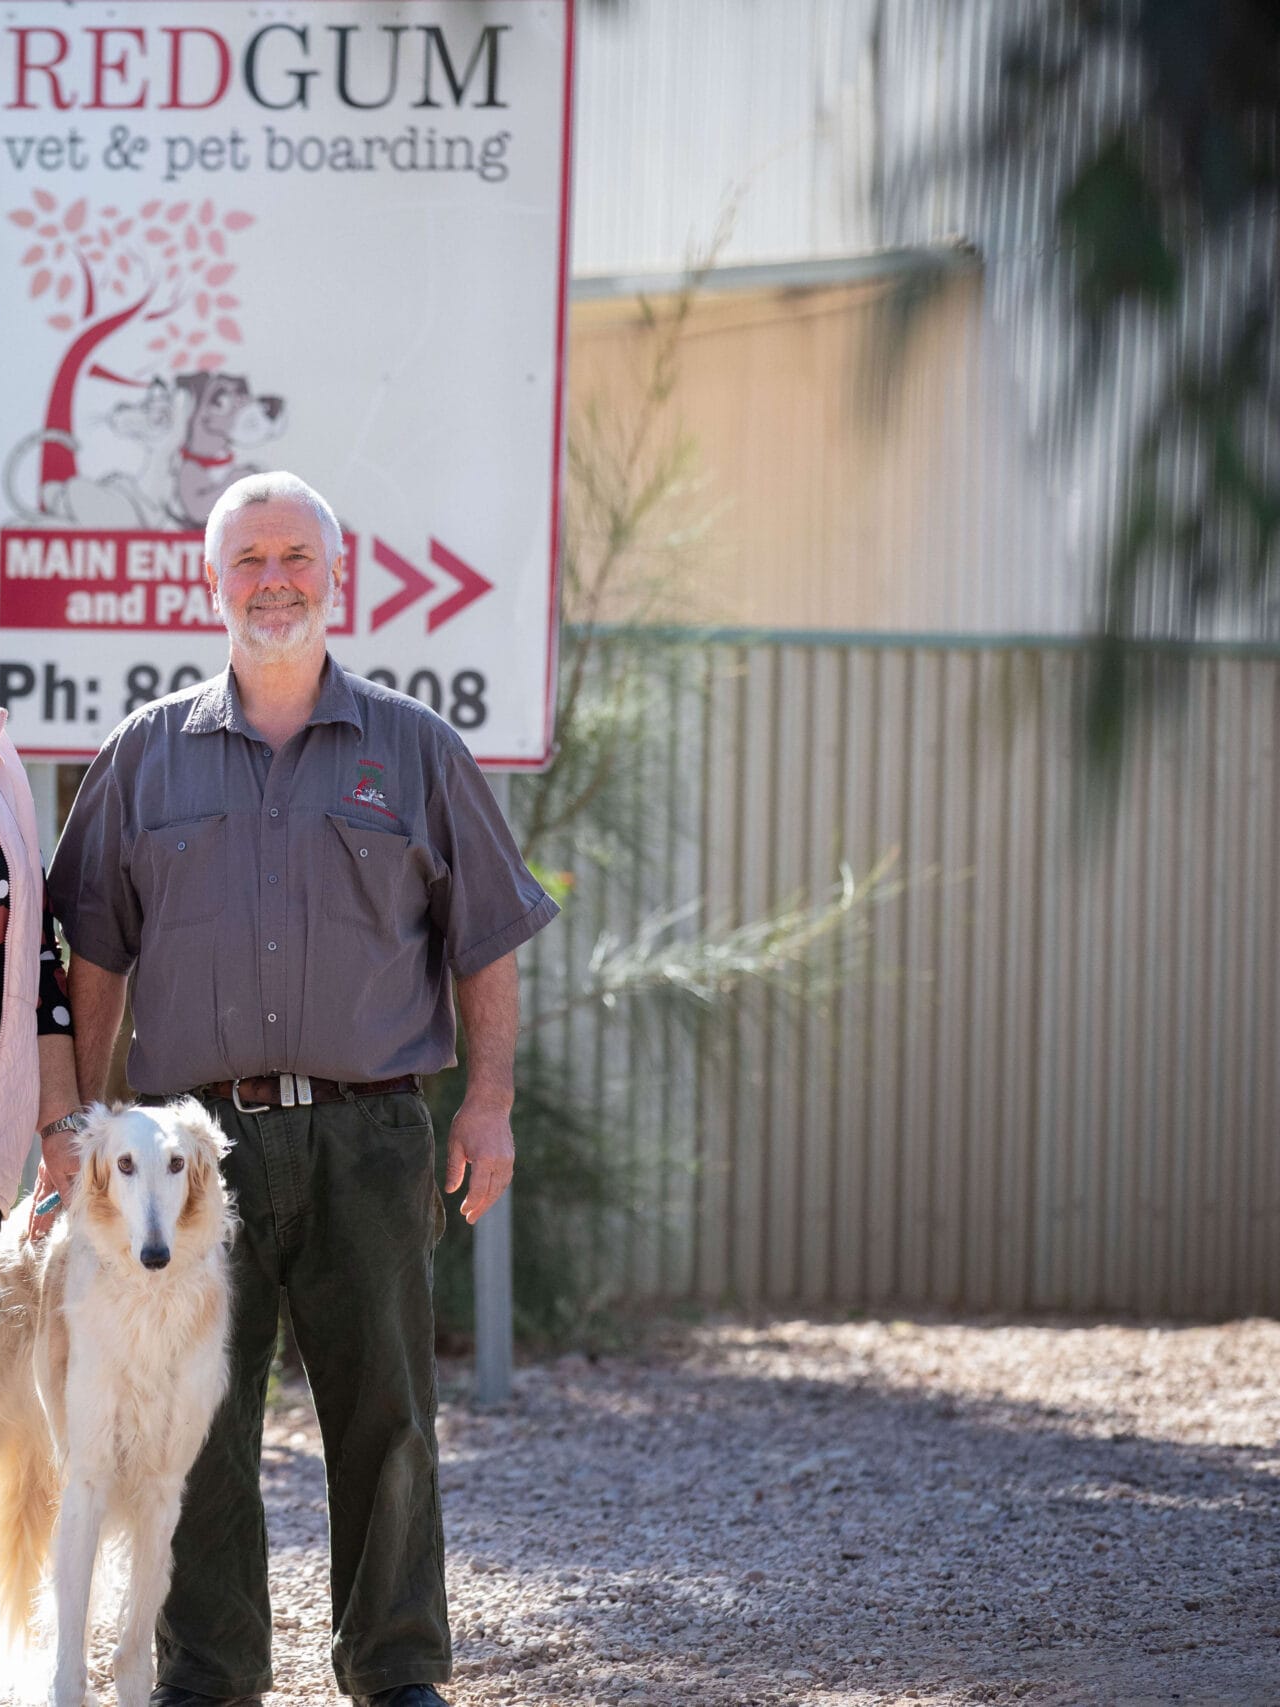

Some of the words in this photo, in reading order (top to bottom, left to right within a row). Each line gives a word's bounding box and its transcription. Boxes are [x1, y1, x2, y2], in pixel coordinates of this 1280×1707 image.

[4, 23, 513, 112] REDGUM
[3, 127, 89, 173] vet
[102, 126, 150, 173] &
[163, 128, 251, 182] pet
[265, 127, 512, 182] boarding
[5, 538, 116, 581] MAIN
[65, 584, 147, 625] and
